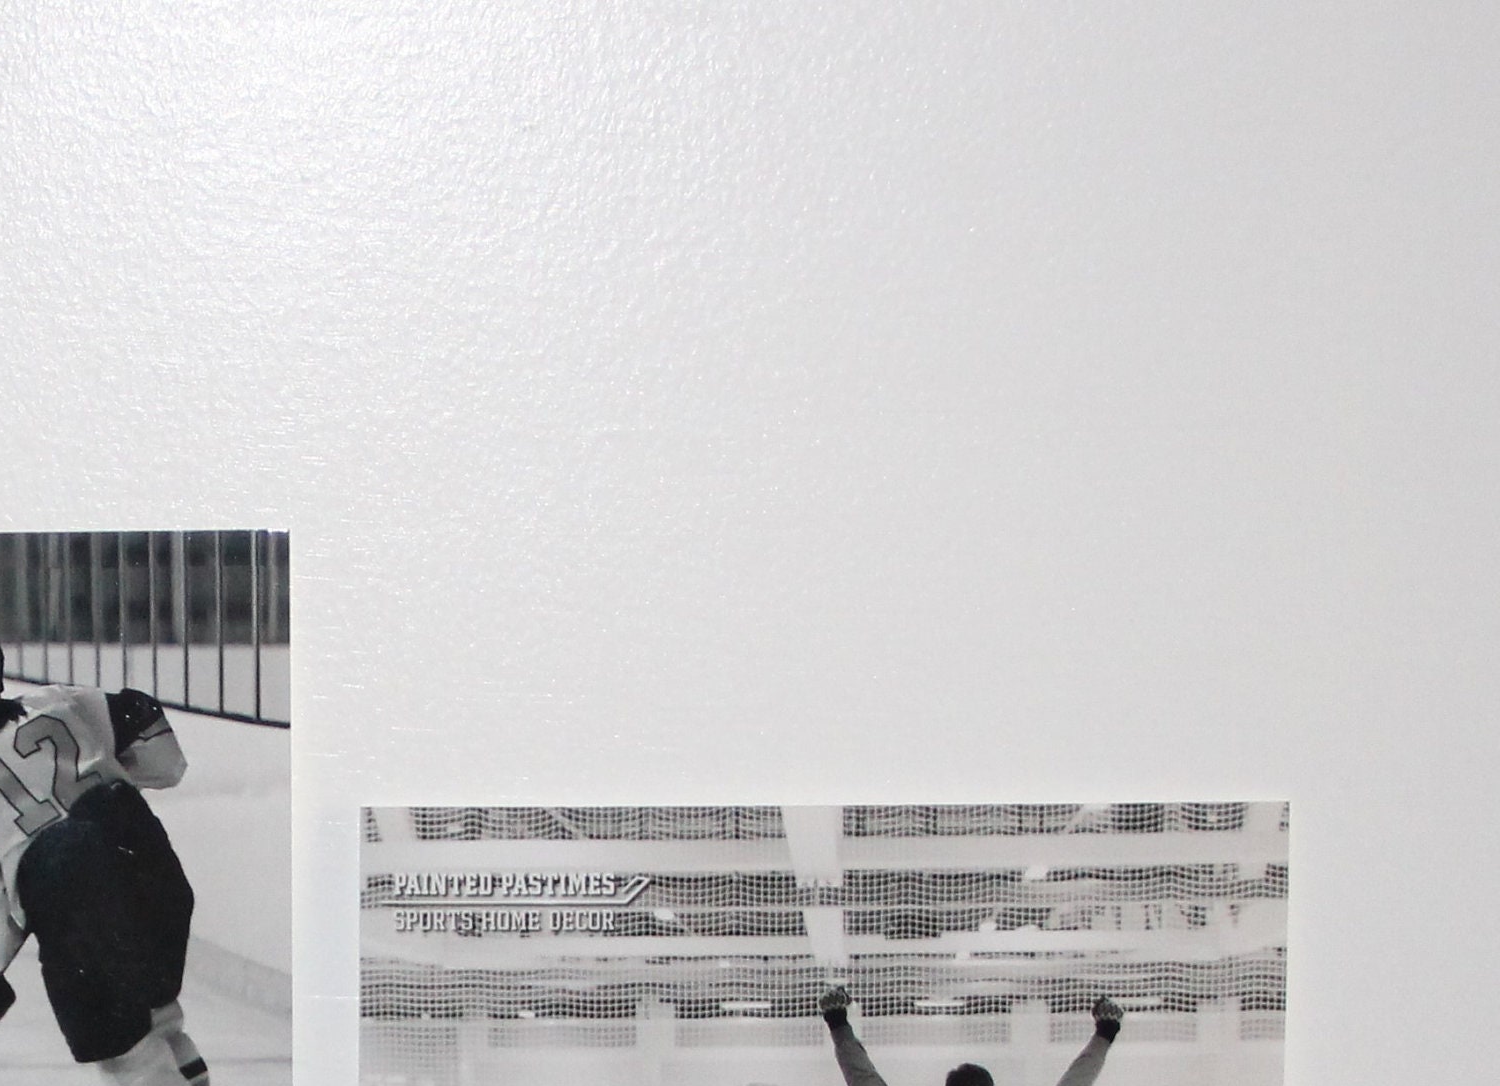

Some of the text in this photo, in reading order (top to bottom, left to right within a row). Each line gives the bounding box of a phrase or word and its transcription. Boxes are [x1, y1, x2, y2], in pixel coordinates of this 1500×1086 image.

[395, 872, 617, 898] PAINTED PASTIMES
[395, 910, 616, 932] SPORTS HOME DECOR
